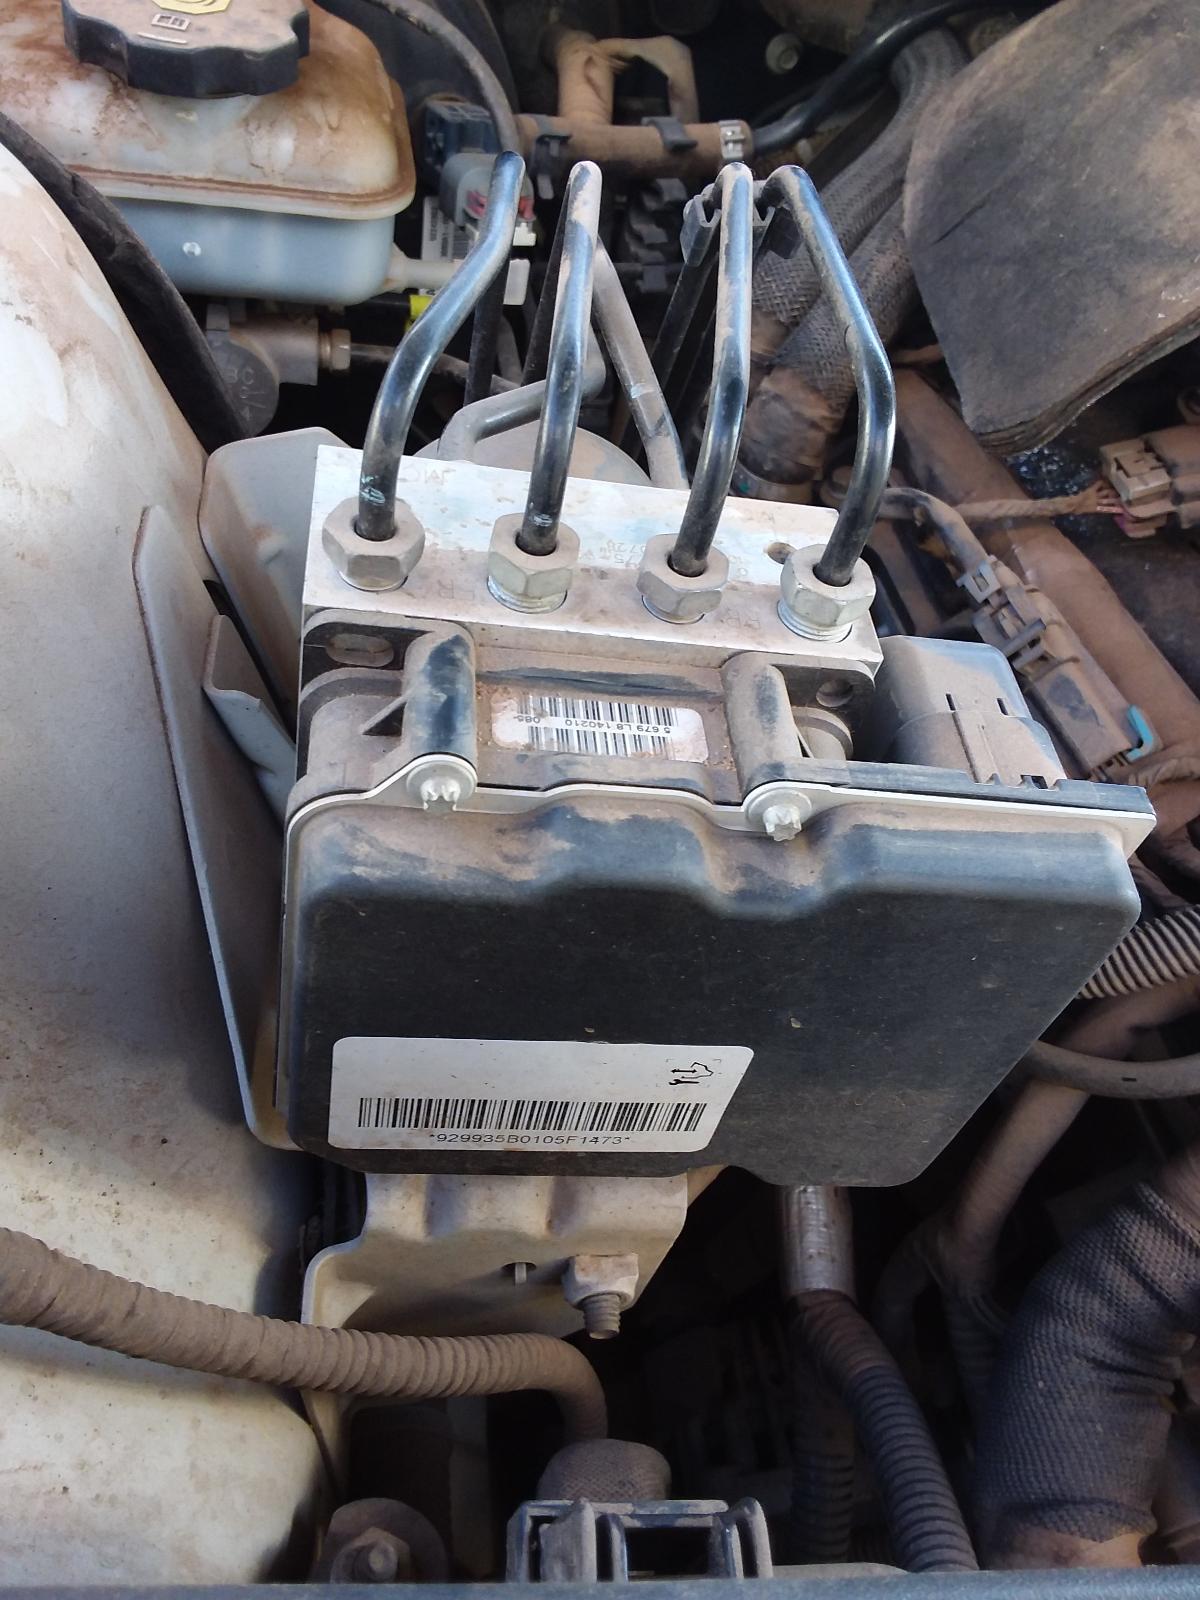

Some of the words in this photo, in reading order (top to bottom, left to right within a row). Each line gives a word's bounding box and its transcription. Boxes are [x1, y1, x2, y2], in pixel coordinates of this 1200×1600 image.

[565, 718, 611, 730] 140210
[616, 723, 632, 732] L8
[637, 724, 660, 733] 679
[663, 725, 672, 734] 5
